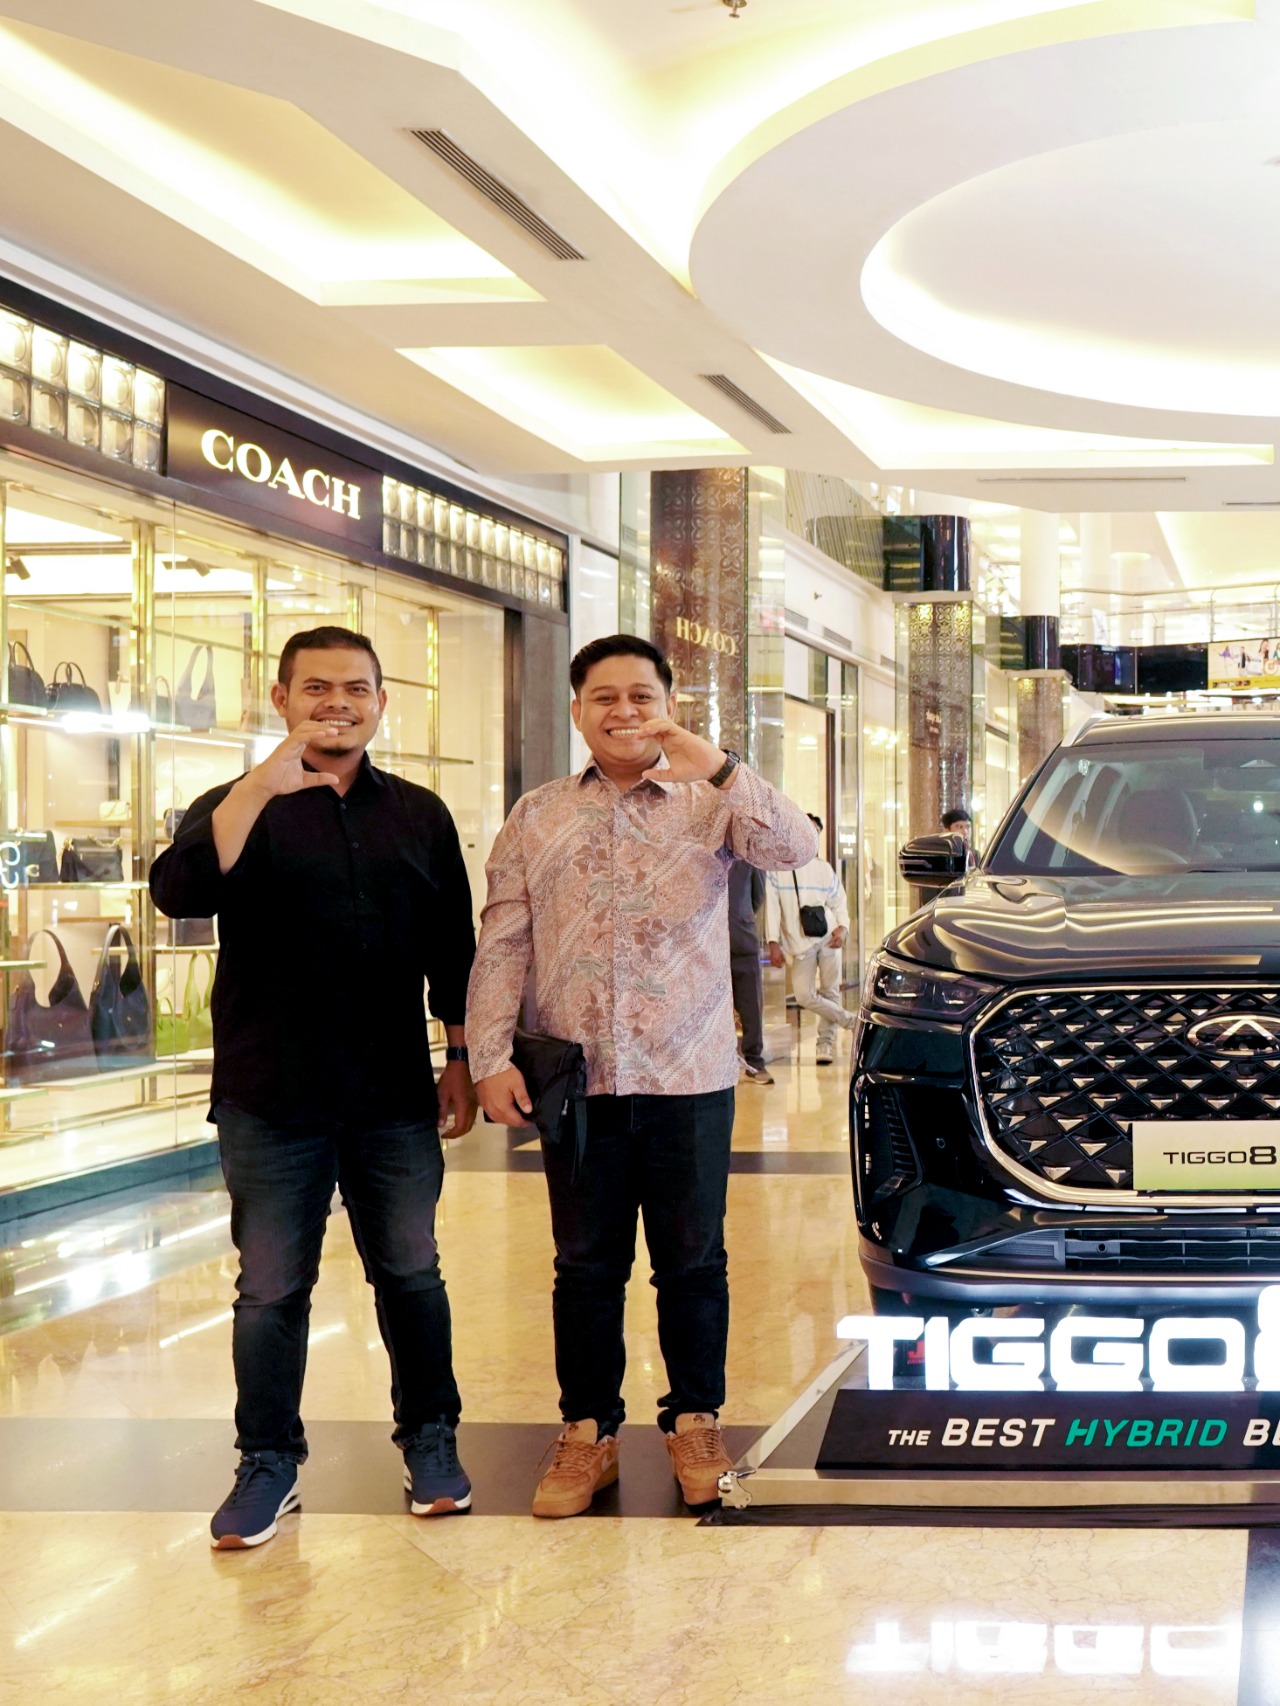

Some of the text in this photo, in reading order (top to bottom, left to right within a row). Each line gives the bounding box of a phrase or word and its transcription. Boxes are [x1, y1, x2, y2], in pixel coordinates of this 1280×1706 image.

[201, 428, 361, 520] COACH
[888, 1429, 931, 1447] THE
[941, 1418, 1056, 1447] BEST
[1065, 1418, 1228, 1448] HYBRID
